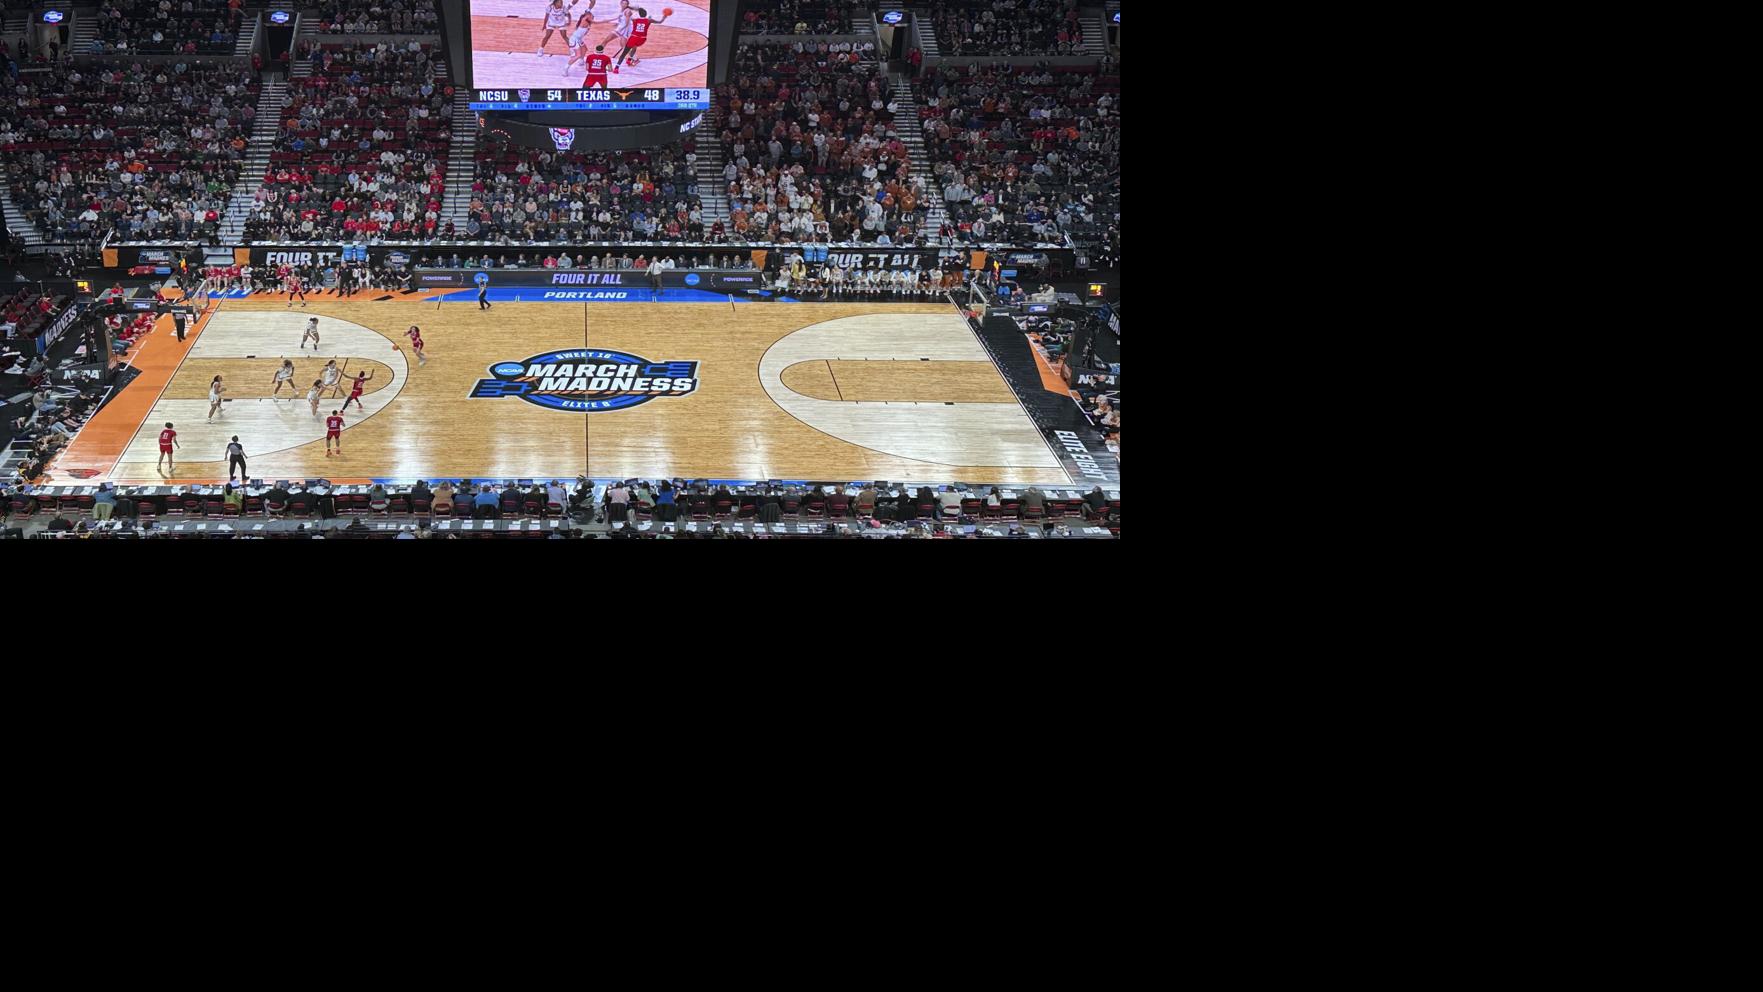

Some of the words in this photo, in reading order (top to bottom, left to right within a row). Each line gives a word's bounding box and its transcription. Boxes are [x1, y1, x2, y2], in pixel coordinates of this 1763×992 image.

[479, 90, 509, 101] NCSU
[547, 90, 562, 101] 54
[576, 90, 611, 101] TEXAS
[644, 90, 660, 101] 48
[675, 90, 700, 100] 38.9
[680, 121, 690, 133] NC
[266, 252, 313, 266] FOUR
[317, 252, 337, 266] IT
[827, 253, 863, 268] OUR
[551, 273, 586, 285] FOUR
[587, 273, 601, 285] IT
[601, 273, 623, 285] ALL
[543, 291, 629, 299] PORTLAND
[555, 351, 594, 359] SWEET
[525, 363, 639, 377] MARCH
[538, 377, 693, 391] MADNESS
[561, 400, 598, 408] ELITE
[1055, 430, 1089, 454] ELITE
[1070, 453, 1108, 481] EIGHT
